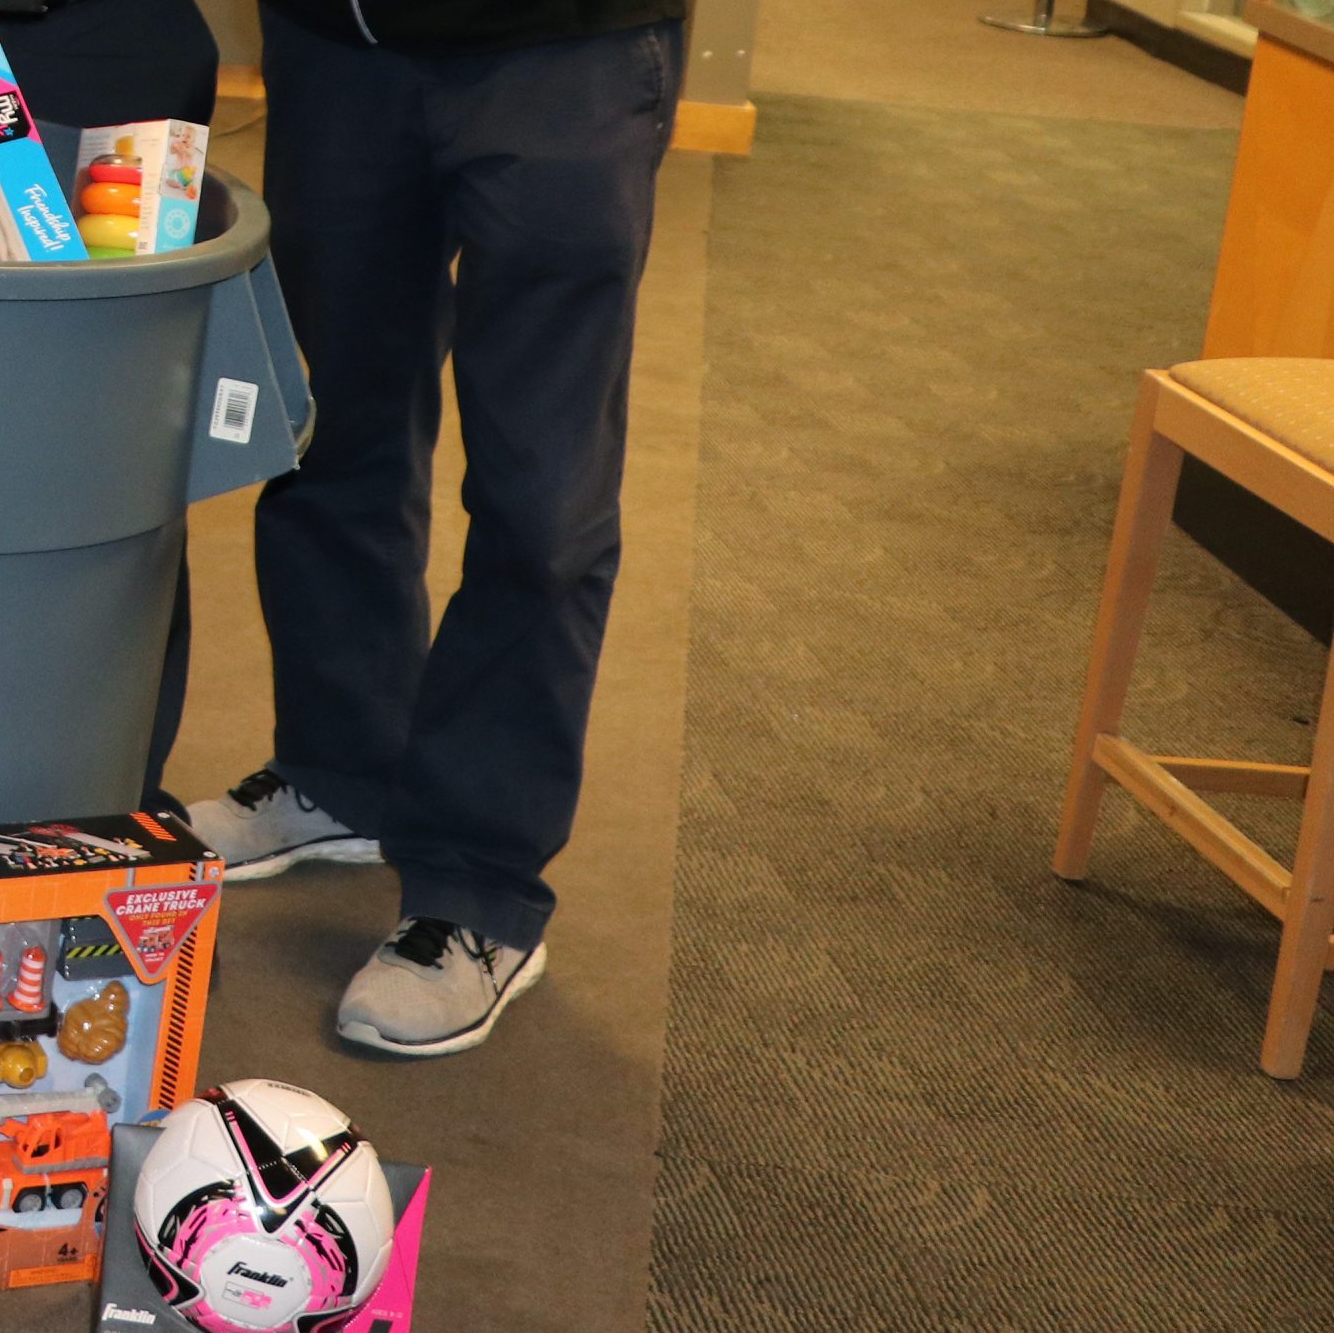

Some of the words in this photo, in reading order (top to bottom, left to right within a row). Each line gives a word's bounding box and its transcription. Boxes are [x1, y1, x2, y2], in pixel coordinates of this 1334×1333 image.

[24, 183, 72, 242] Friendship
[16, 204, 64, 251] Inspired!
[116, 902, 160, 916] CRANE
[163, 898, 206, 911] TRUCK
[126, 888, 198, 905] EXCLUSIVE
[57, 1242, 79, 1257] 4+
[226, 1260, 288, 1287] Franklin
